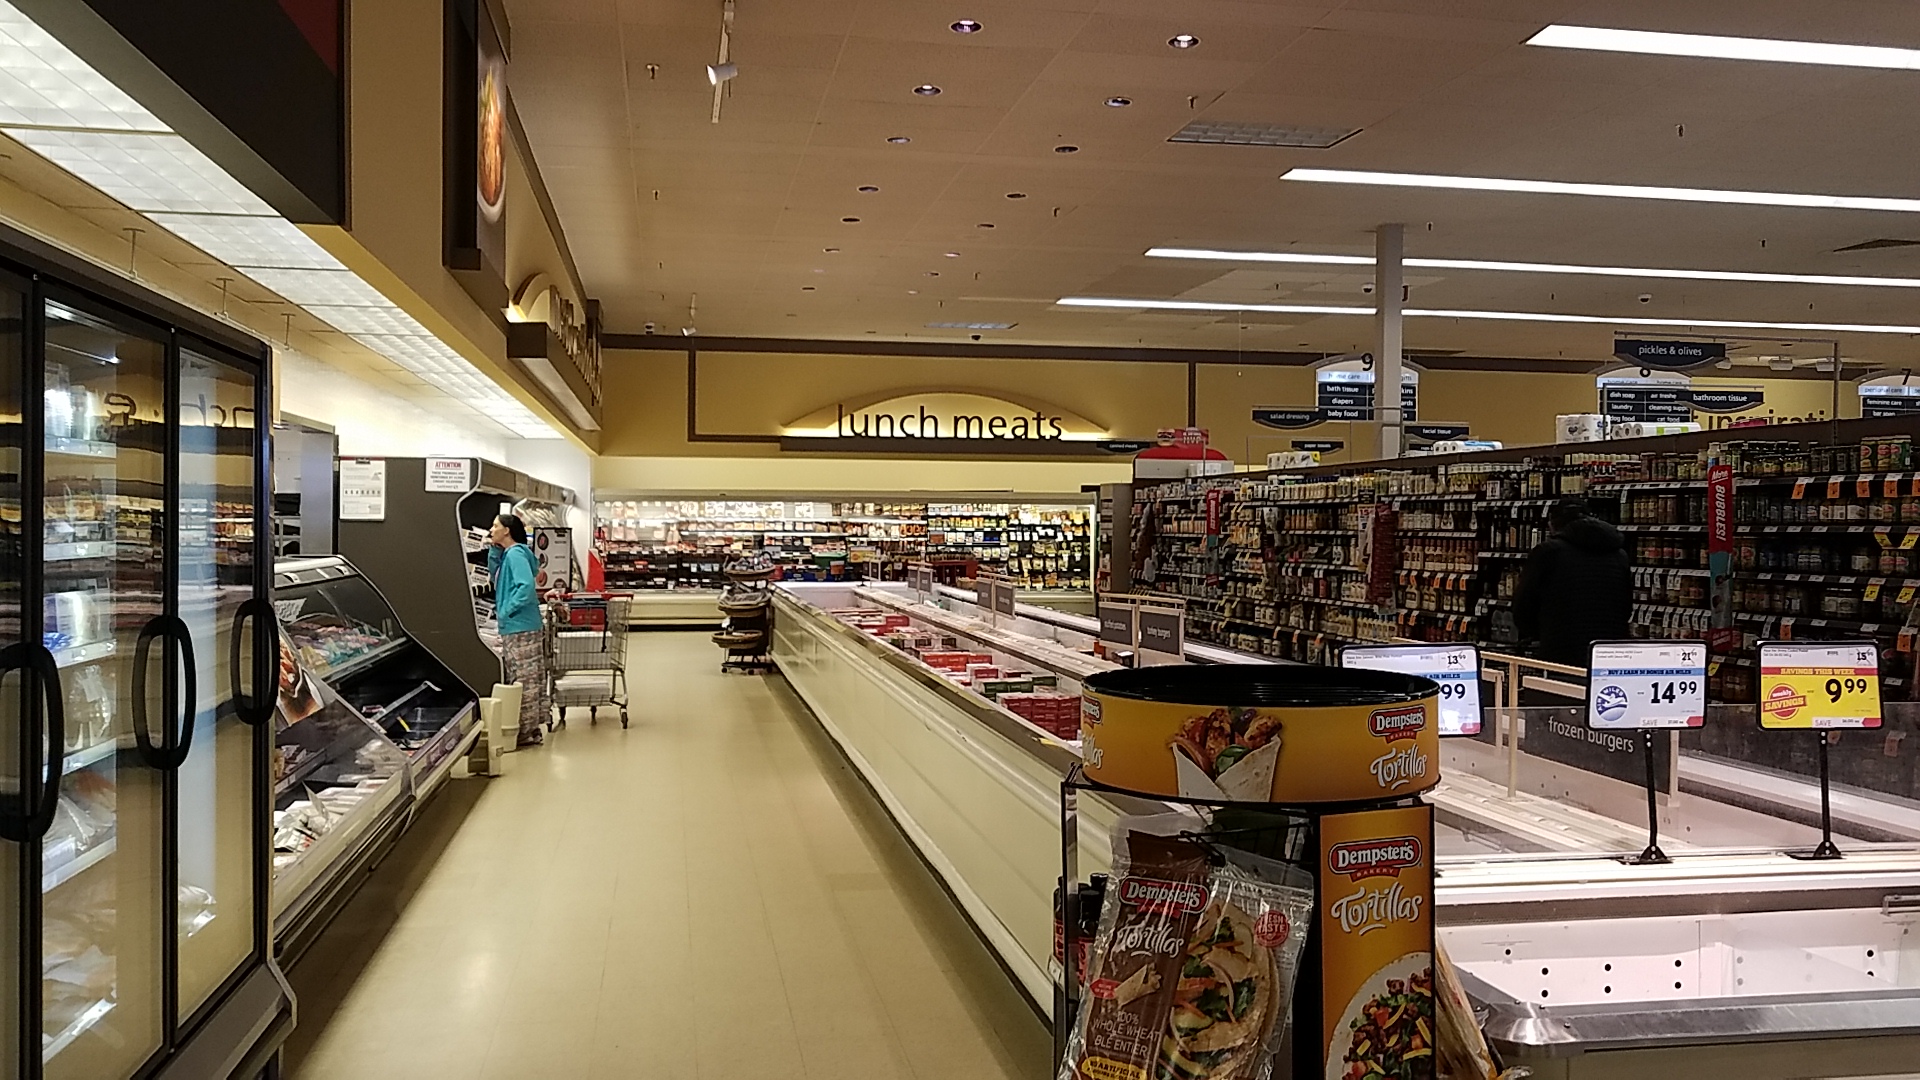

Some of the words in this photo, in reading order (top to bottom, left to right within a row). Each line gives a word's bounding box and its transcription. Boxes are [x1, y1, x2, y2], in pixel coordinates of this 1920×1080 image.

[1638, 345, 1667, 356] pickles
[1669, 346, 1676, 355] &
[1677, 346, 1702, 356] olives
[1360, 352, 1374, 371] 9
[1901, 368, 1911, 385] 7
[1331, 397, 1354, 405] diapers
[1693, 393, 1727, 401] bathroom
[1728, 394, 1748, 402] tissue
[1327, 409, 1343, 418] baby
[1611, 403, 1633, 411] laundry
[1648, 404, 1672, 412] cleaning
[837, 403, 939, 439] lunch
[953, 411, 1063, 440] meats
[1269, 412, 1285, 420] salad
[1285, 412, 1310, 421] dressing
[1715, 484, 1726, 541] BUBBLES!
[1764, 697, 1804, 710] SAVINGS
[1375, 708, 1424, 731] Dempster's
[1815, 719, 1832, 727] SAVE
[1548, 715, 1585, 740] frozen
[1587, 728, 1634, 752] burgers
[1369, 743, 1428, 788] Tortillas
[1337, 841, 1415, 868] Dempster's
[1356, 867, 1394, 878] BAKERY
[1330, 881, 1423, 933] Tortillas
[1117, 922, 1185, 958] Tortillas
[1093, 1018, 1125, 1034] WHOLE
[1125, 1024, 1161, 1042] WHEAT
[1113, 1039, 1148, 1057] ENTIER
